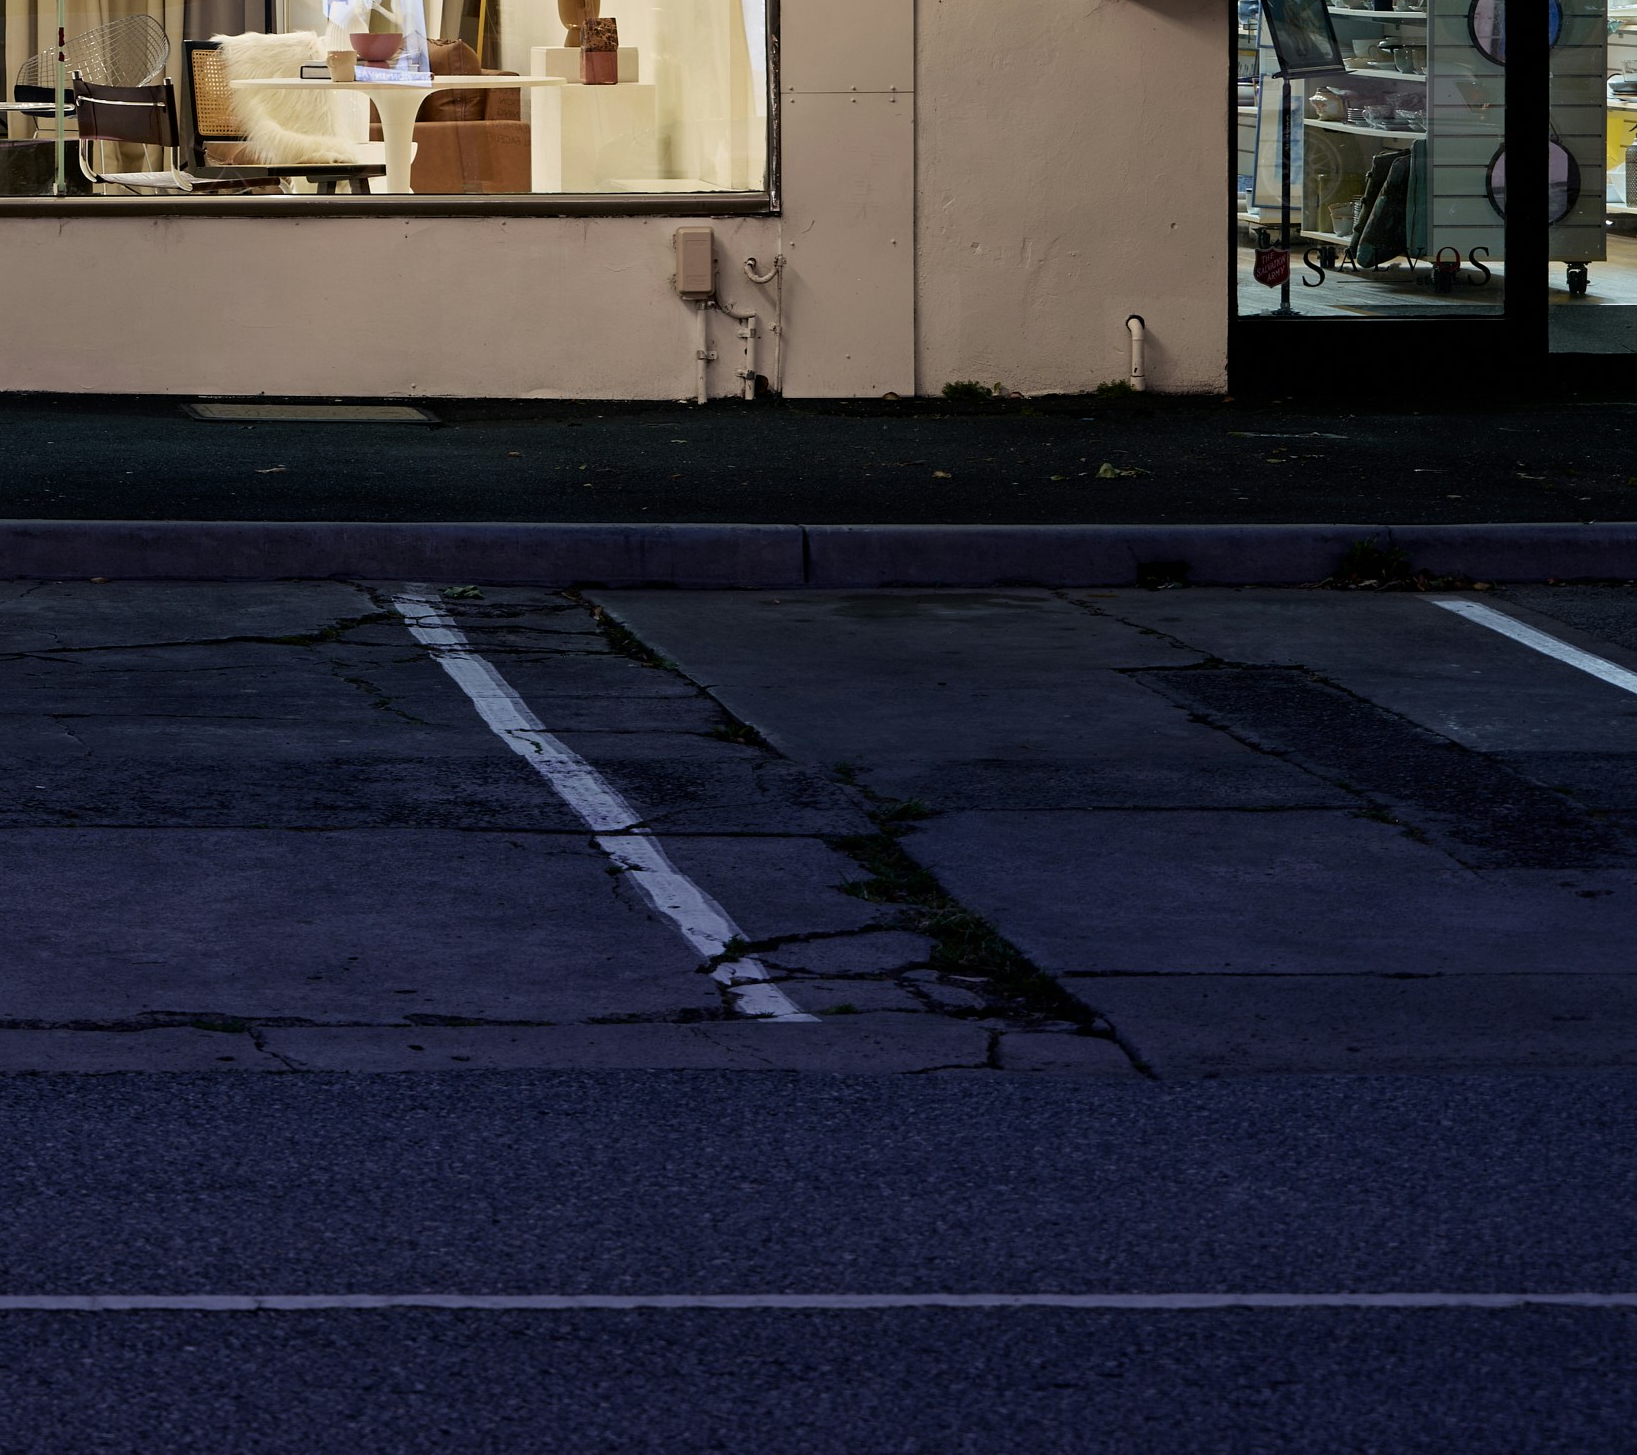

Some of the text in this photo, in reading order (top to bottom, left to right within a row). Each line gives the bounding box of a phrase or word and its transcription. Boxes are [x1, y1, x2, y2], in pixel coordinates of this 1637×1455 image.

[1256, 253, 1287, 278] SALVATION
[1261, 251, 1275, 264] THE
[1302, 246, 1491, 287] SALVOS
[1266, 264, 1285, 283] ARMY
